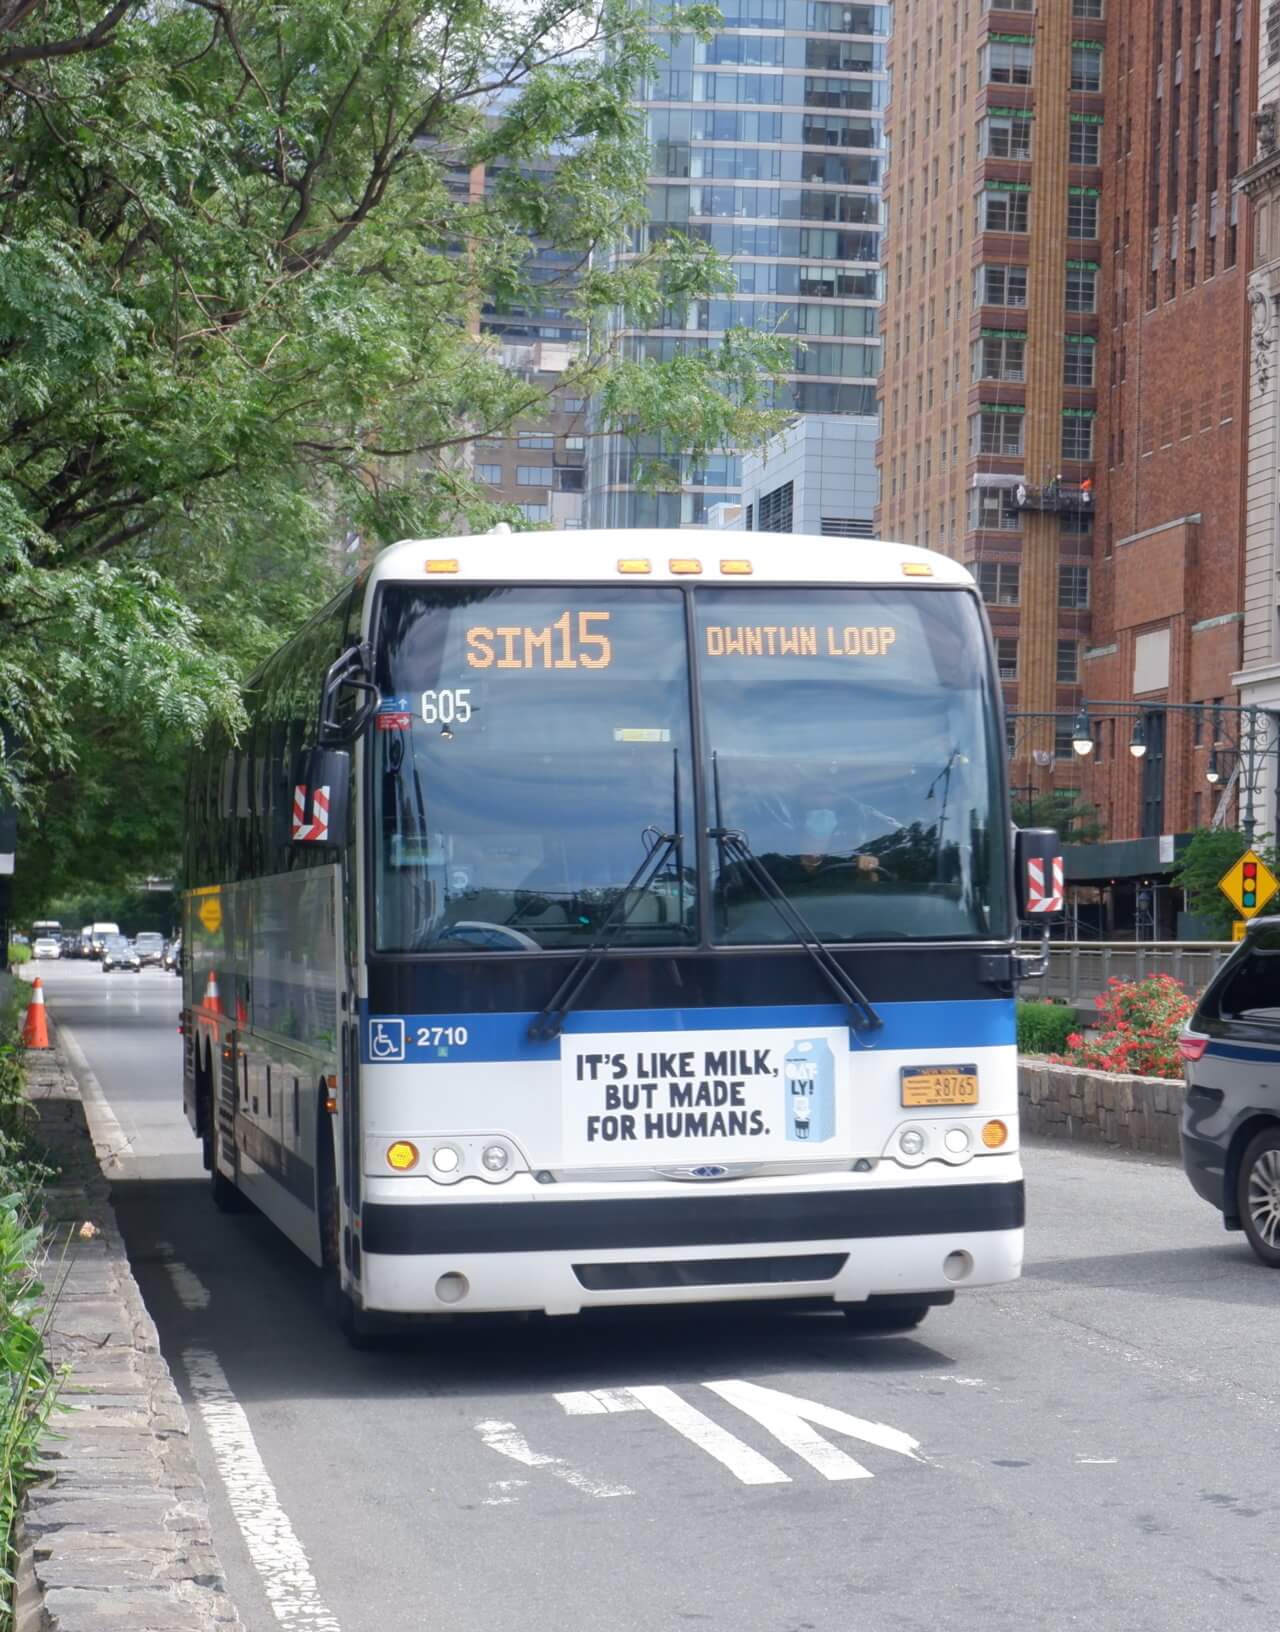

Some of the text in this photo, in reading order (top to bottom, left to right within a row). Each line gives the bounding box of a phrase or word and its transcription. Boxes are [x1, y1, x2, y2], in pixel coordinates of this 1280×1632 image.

[466, 611, 611, 669] SIM15
[706, 626, 897, 656] DWNTWN LOOP
[421, 689, 472, 724] 605
[416, 1026, 468, 1046] 2710
[576, 1049, 779, 1081] IT'S LIKE MILK,
[605, 1080, 746, 1111] BUT MADE
[791, 1080, 814, 1096] LY!
[587, 1110, 771, 1142] FOR HUMANS.
